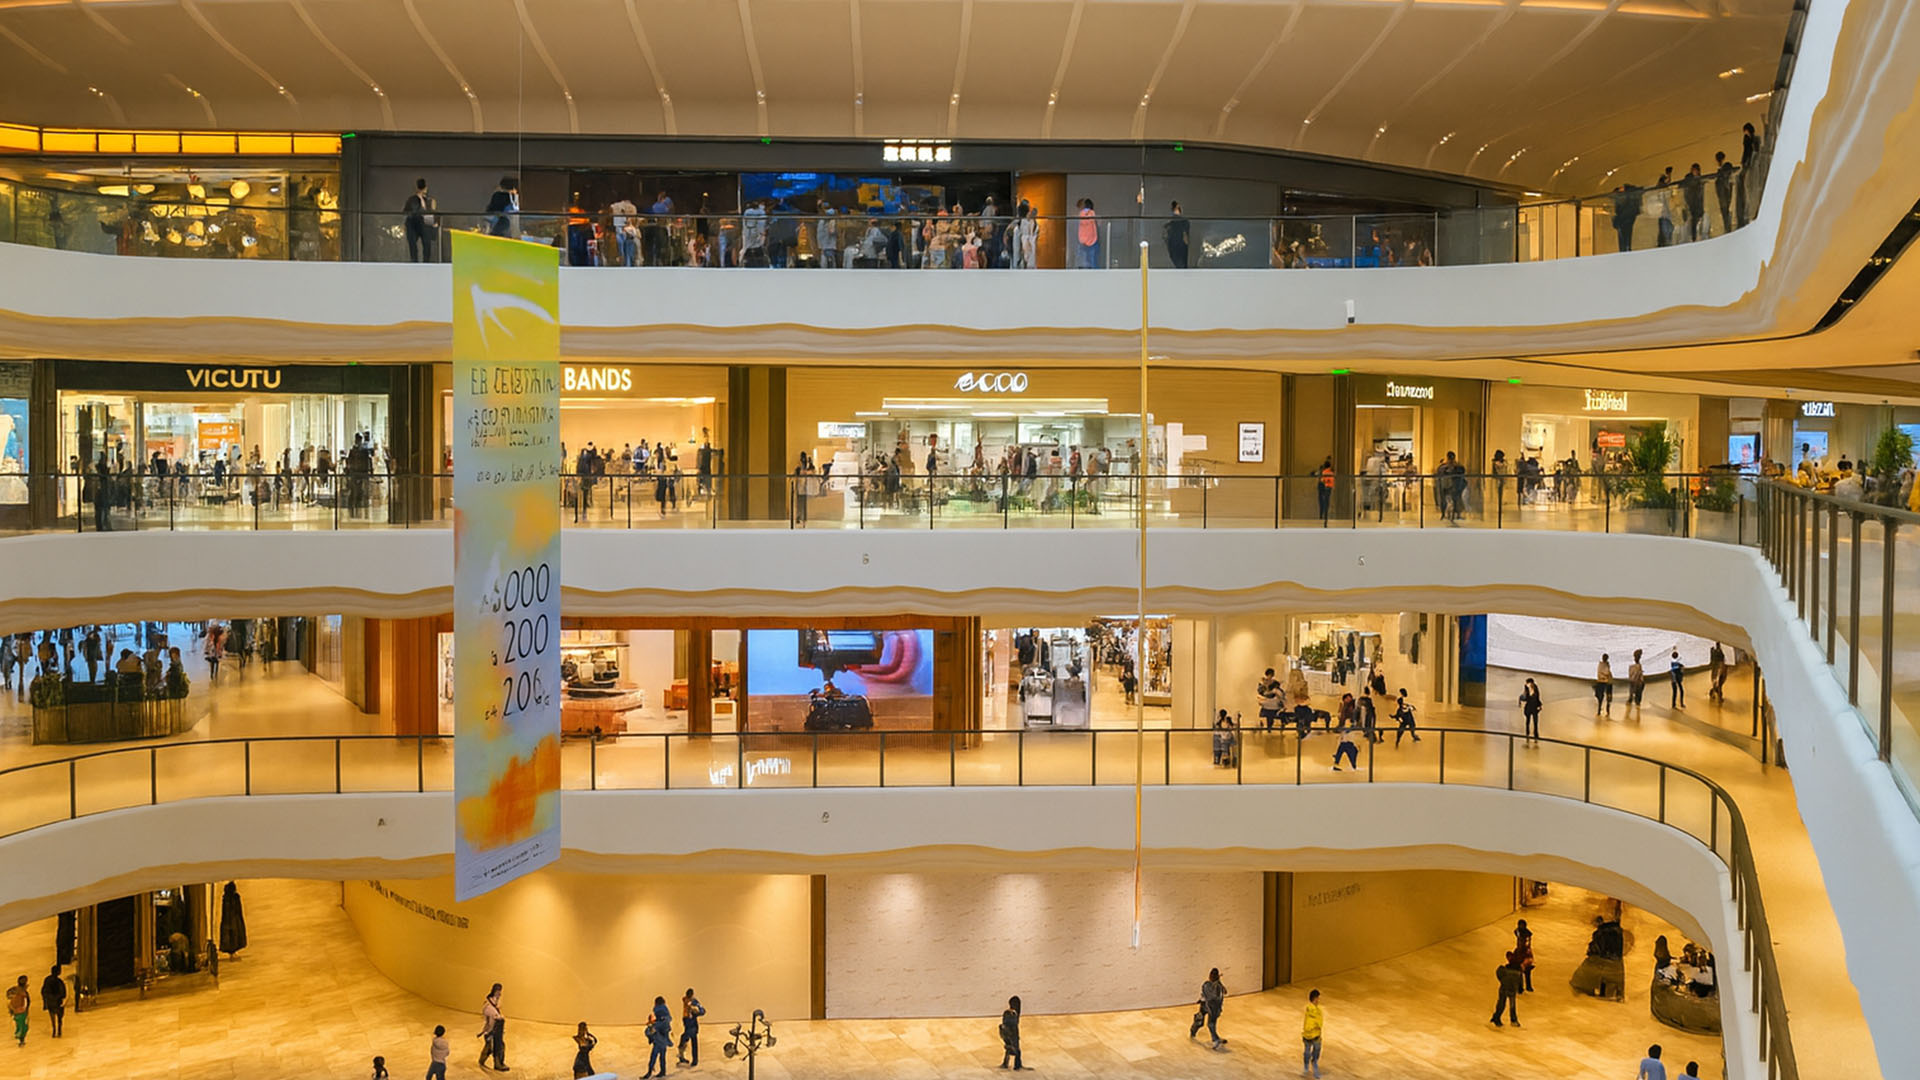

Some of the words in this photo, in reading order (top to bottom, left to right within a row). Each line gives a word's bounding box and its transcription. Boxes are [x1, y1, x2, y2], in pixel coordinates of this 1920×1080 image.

[185, 368, 281, 389] VICUTU
[564, 367, 633, 391] BANDS
[504, 613, 549, 664] 200
